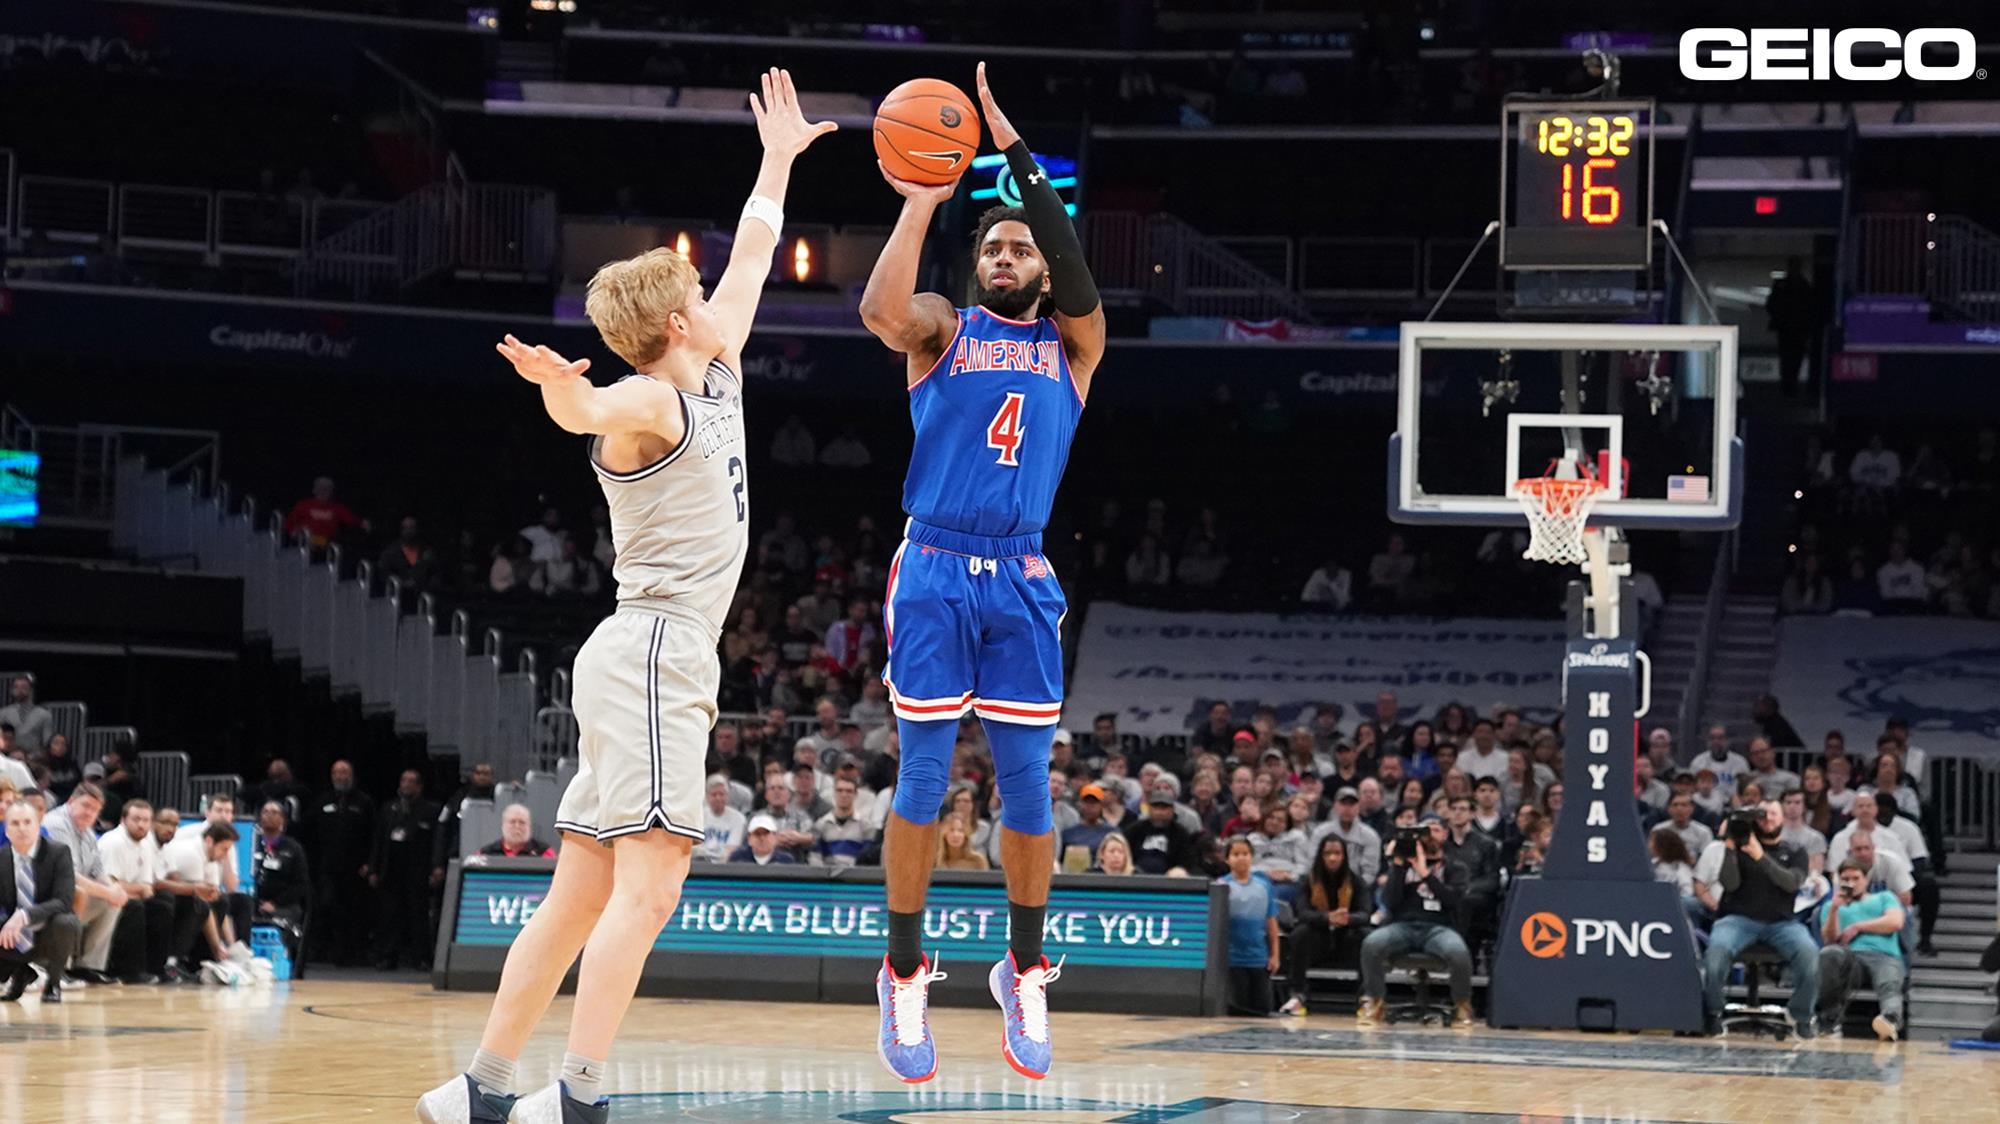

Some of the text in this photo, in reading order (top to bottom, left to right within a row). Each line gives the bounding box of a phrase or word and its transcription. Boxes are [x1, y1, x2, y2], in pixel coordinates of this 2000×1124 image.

[1538, 116, 1634, 157] 12:32
[1561, 157, 1621, 225] 16
[949, 335, 1060, 383] AMERICAN
[987, 392, 1026, 467] 4
[728, 456, 745, 522] 2
[1568, 652, 1630, 669] SPALDING
[1586, 691, 1611, 863] HOYAS
[680, 901, 774, 933] HOYA
[923, 908, 995, 939] UST
[1098, 913, 1181, 946] YOU.
[1571, 917, 1674, 960] PNC
